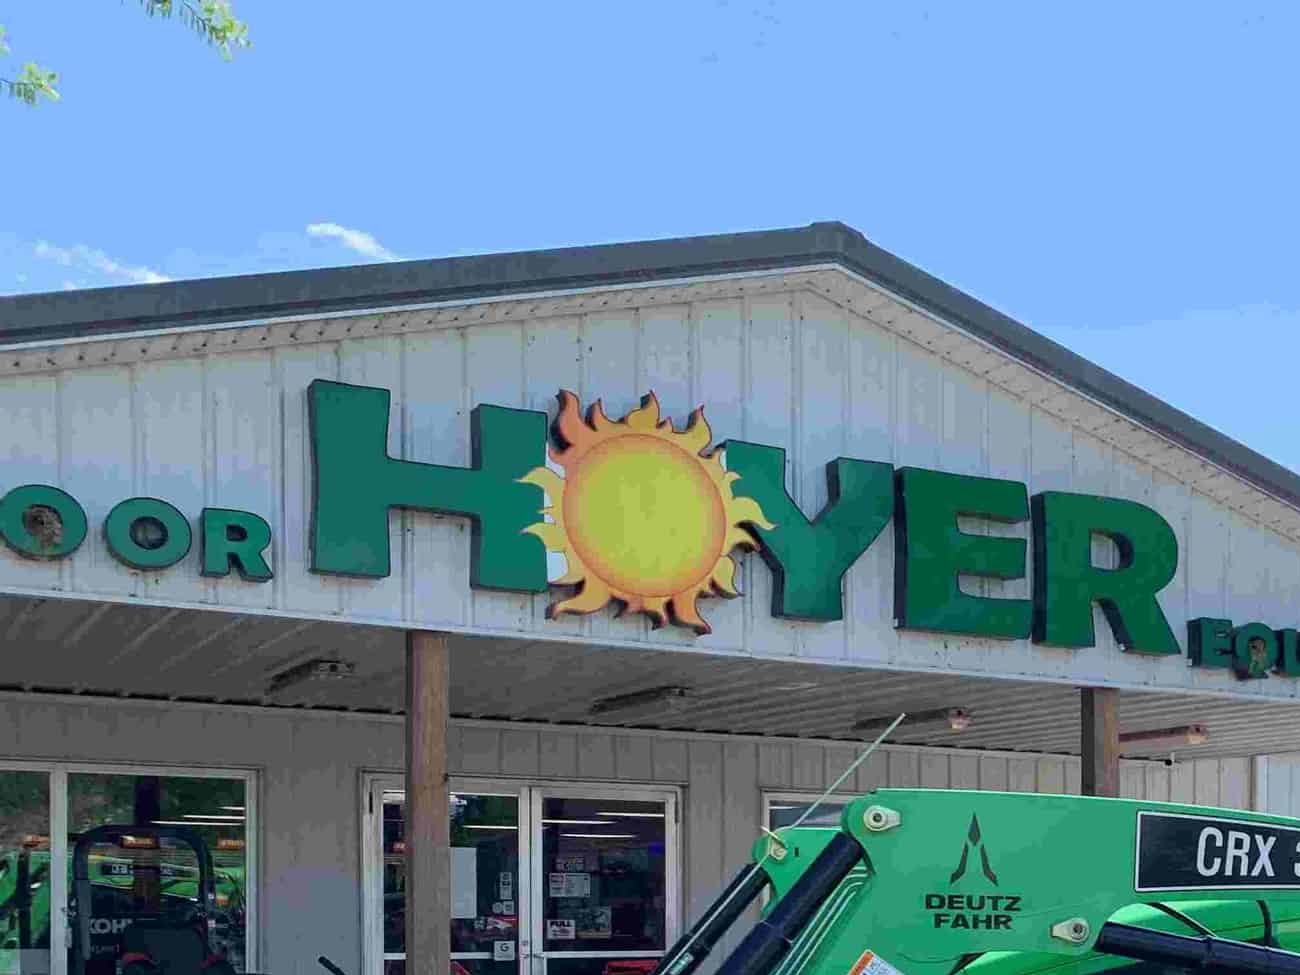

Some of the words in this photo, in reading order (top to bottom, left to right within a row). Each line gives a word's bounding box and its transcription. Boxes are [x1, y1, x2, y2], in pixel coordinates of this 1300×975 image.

[1196, 826, 1277, 877] CRX
[925, 894, 1022, 911] DEUTZ
[934, 913, 1013, 929] FAHR
